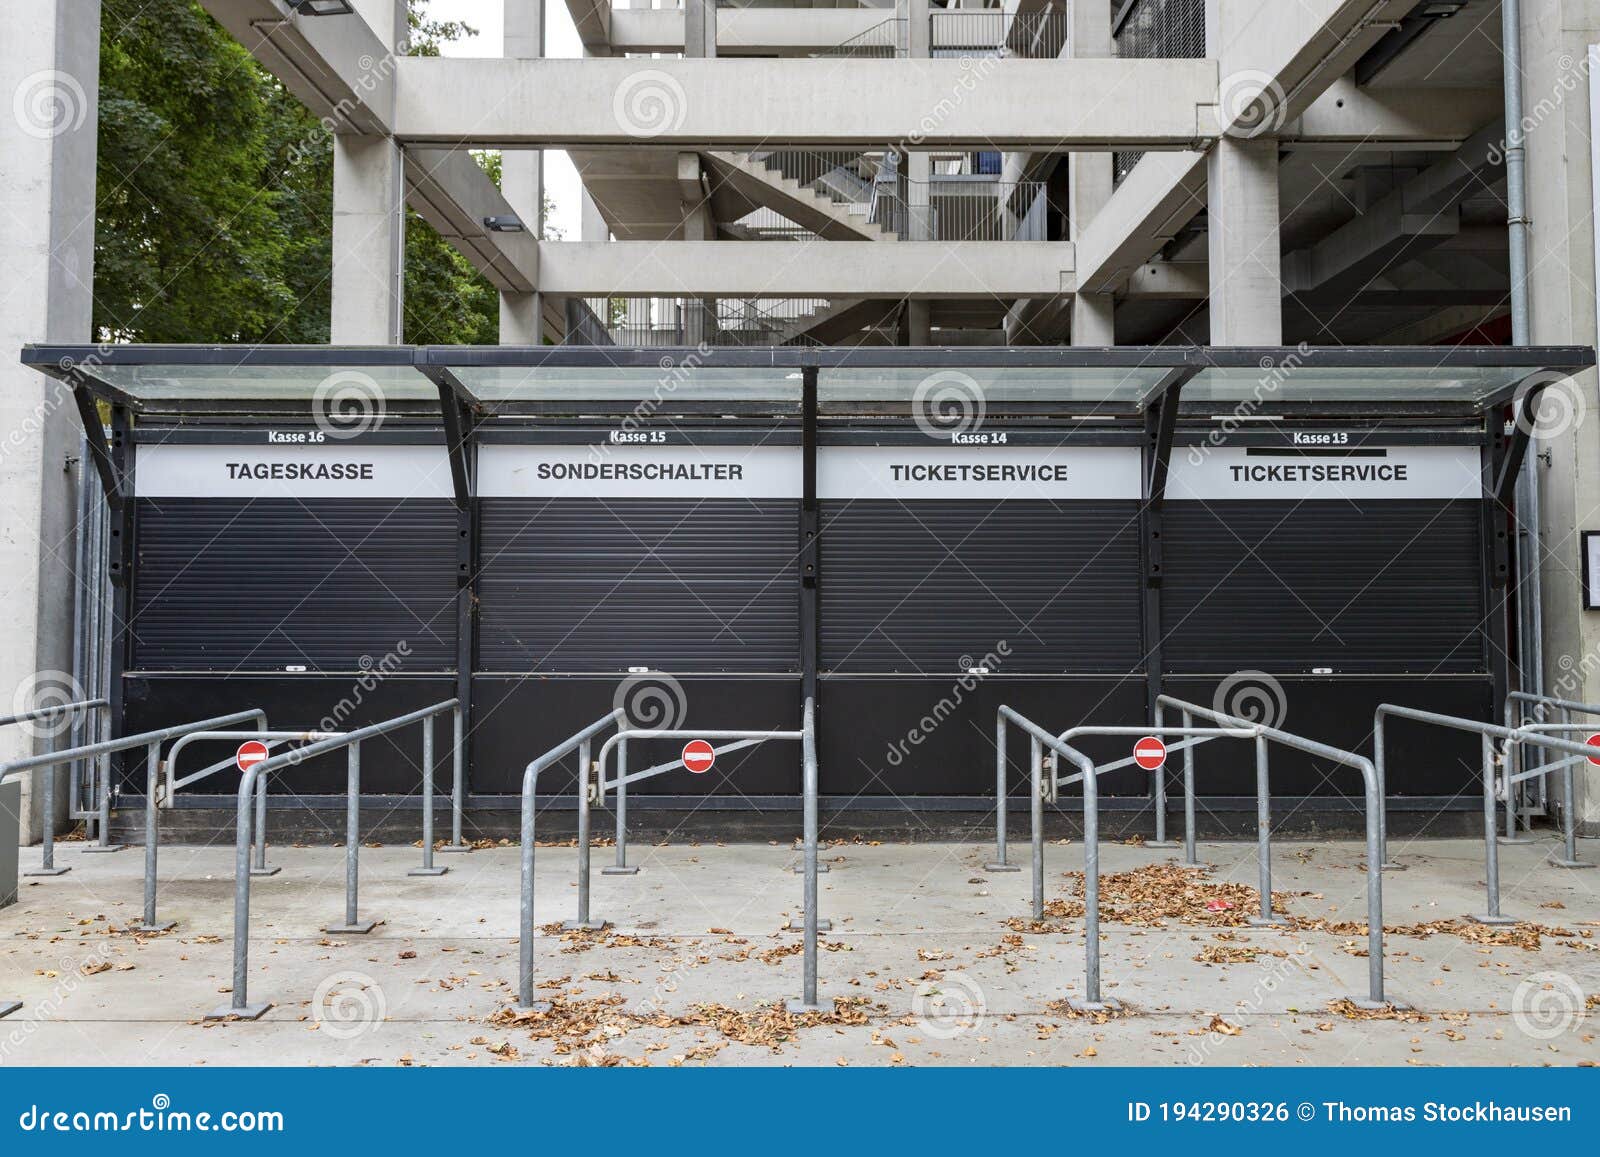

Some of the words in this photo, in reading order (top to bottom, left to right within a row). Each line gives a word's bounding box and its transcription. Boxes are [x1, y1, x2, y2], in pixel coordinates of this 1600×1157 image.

[268, 431, 305, 443] Kasse
[309, 431, 324, 443] 16
[610, 431, 647, 443] Kasse
[650, 431, 666, 442] 15
[952, 432, 988, 444] Kasse
[991, 432, 1007, 444] 14
[1293, 432, 1330, 444] Kasse
[1333, 432, 1348, 444] 13
[226, 463, 373, 480] TAGESKASSE
[537, 463, 743, 480] SONDERSCHALTER
[890, 464, 1068, 482] TICKETSERVICE
[1230, 464, 1408, 482] TICKETSERVICE
